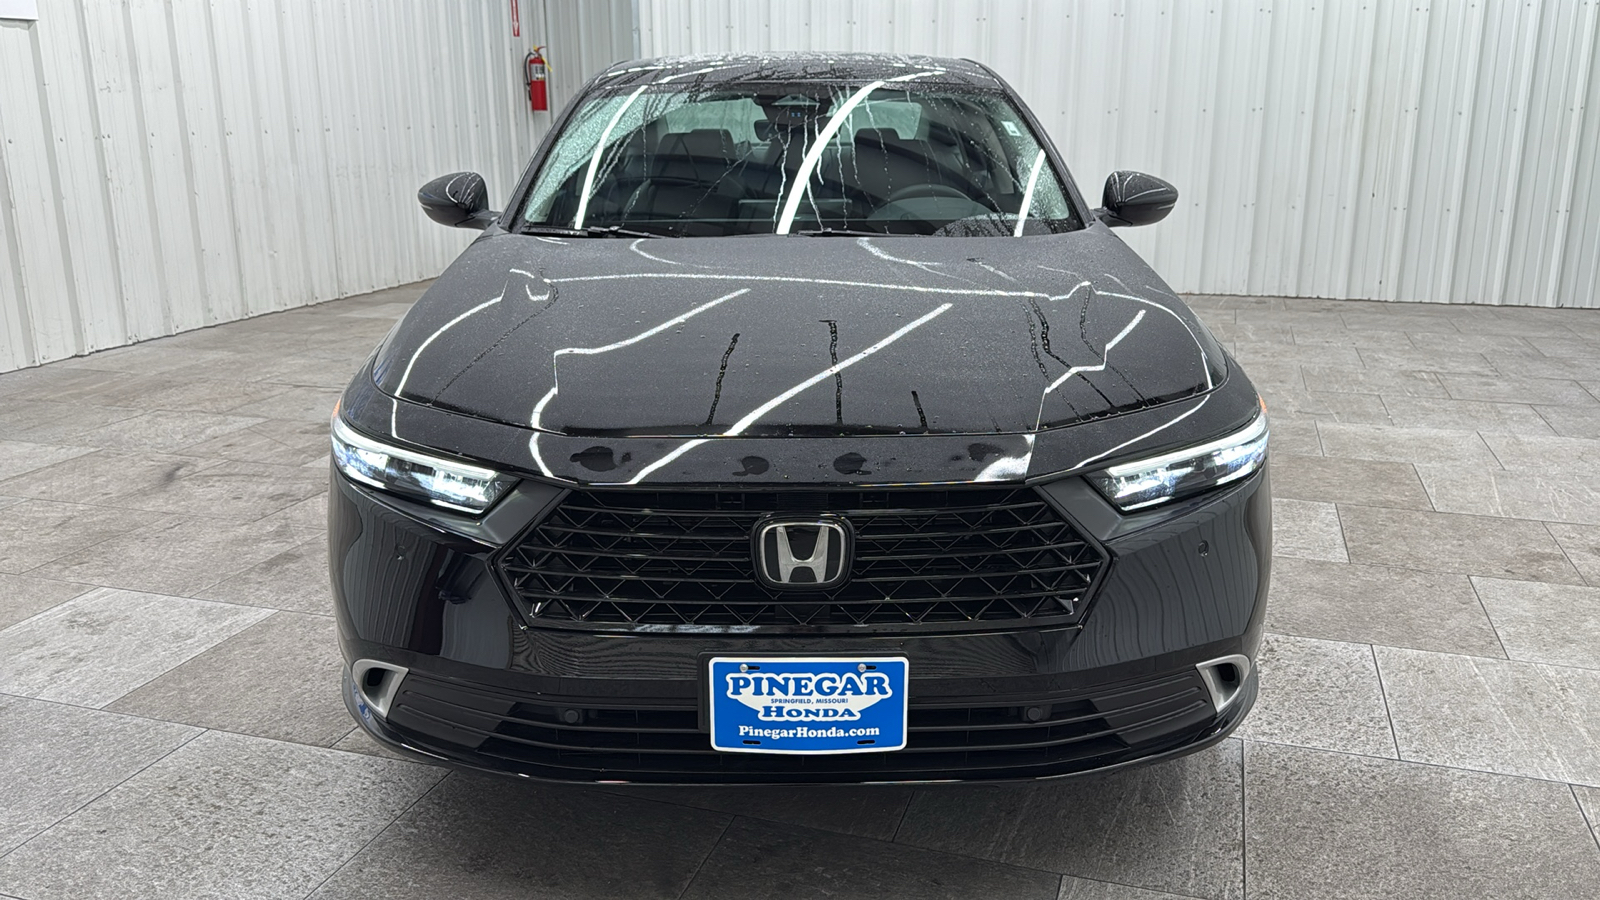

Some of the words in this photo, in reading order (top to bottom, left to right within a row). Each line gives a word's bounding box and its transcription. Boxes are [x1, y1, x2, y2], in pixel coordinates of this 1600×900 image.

[730, 676, 889, 697] PINEGAR
[762, 705, 858, 718] HONDA
[738, 725, 880, 740] PinegarHonda.com
